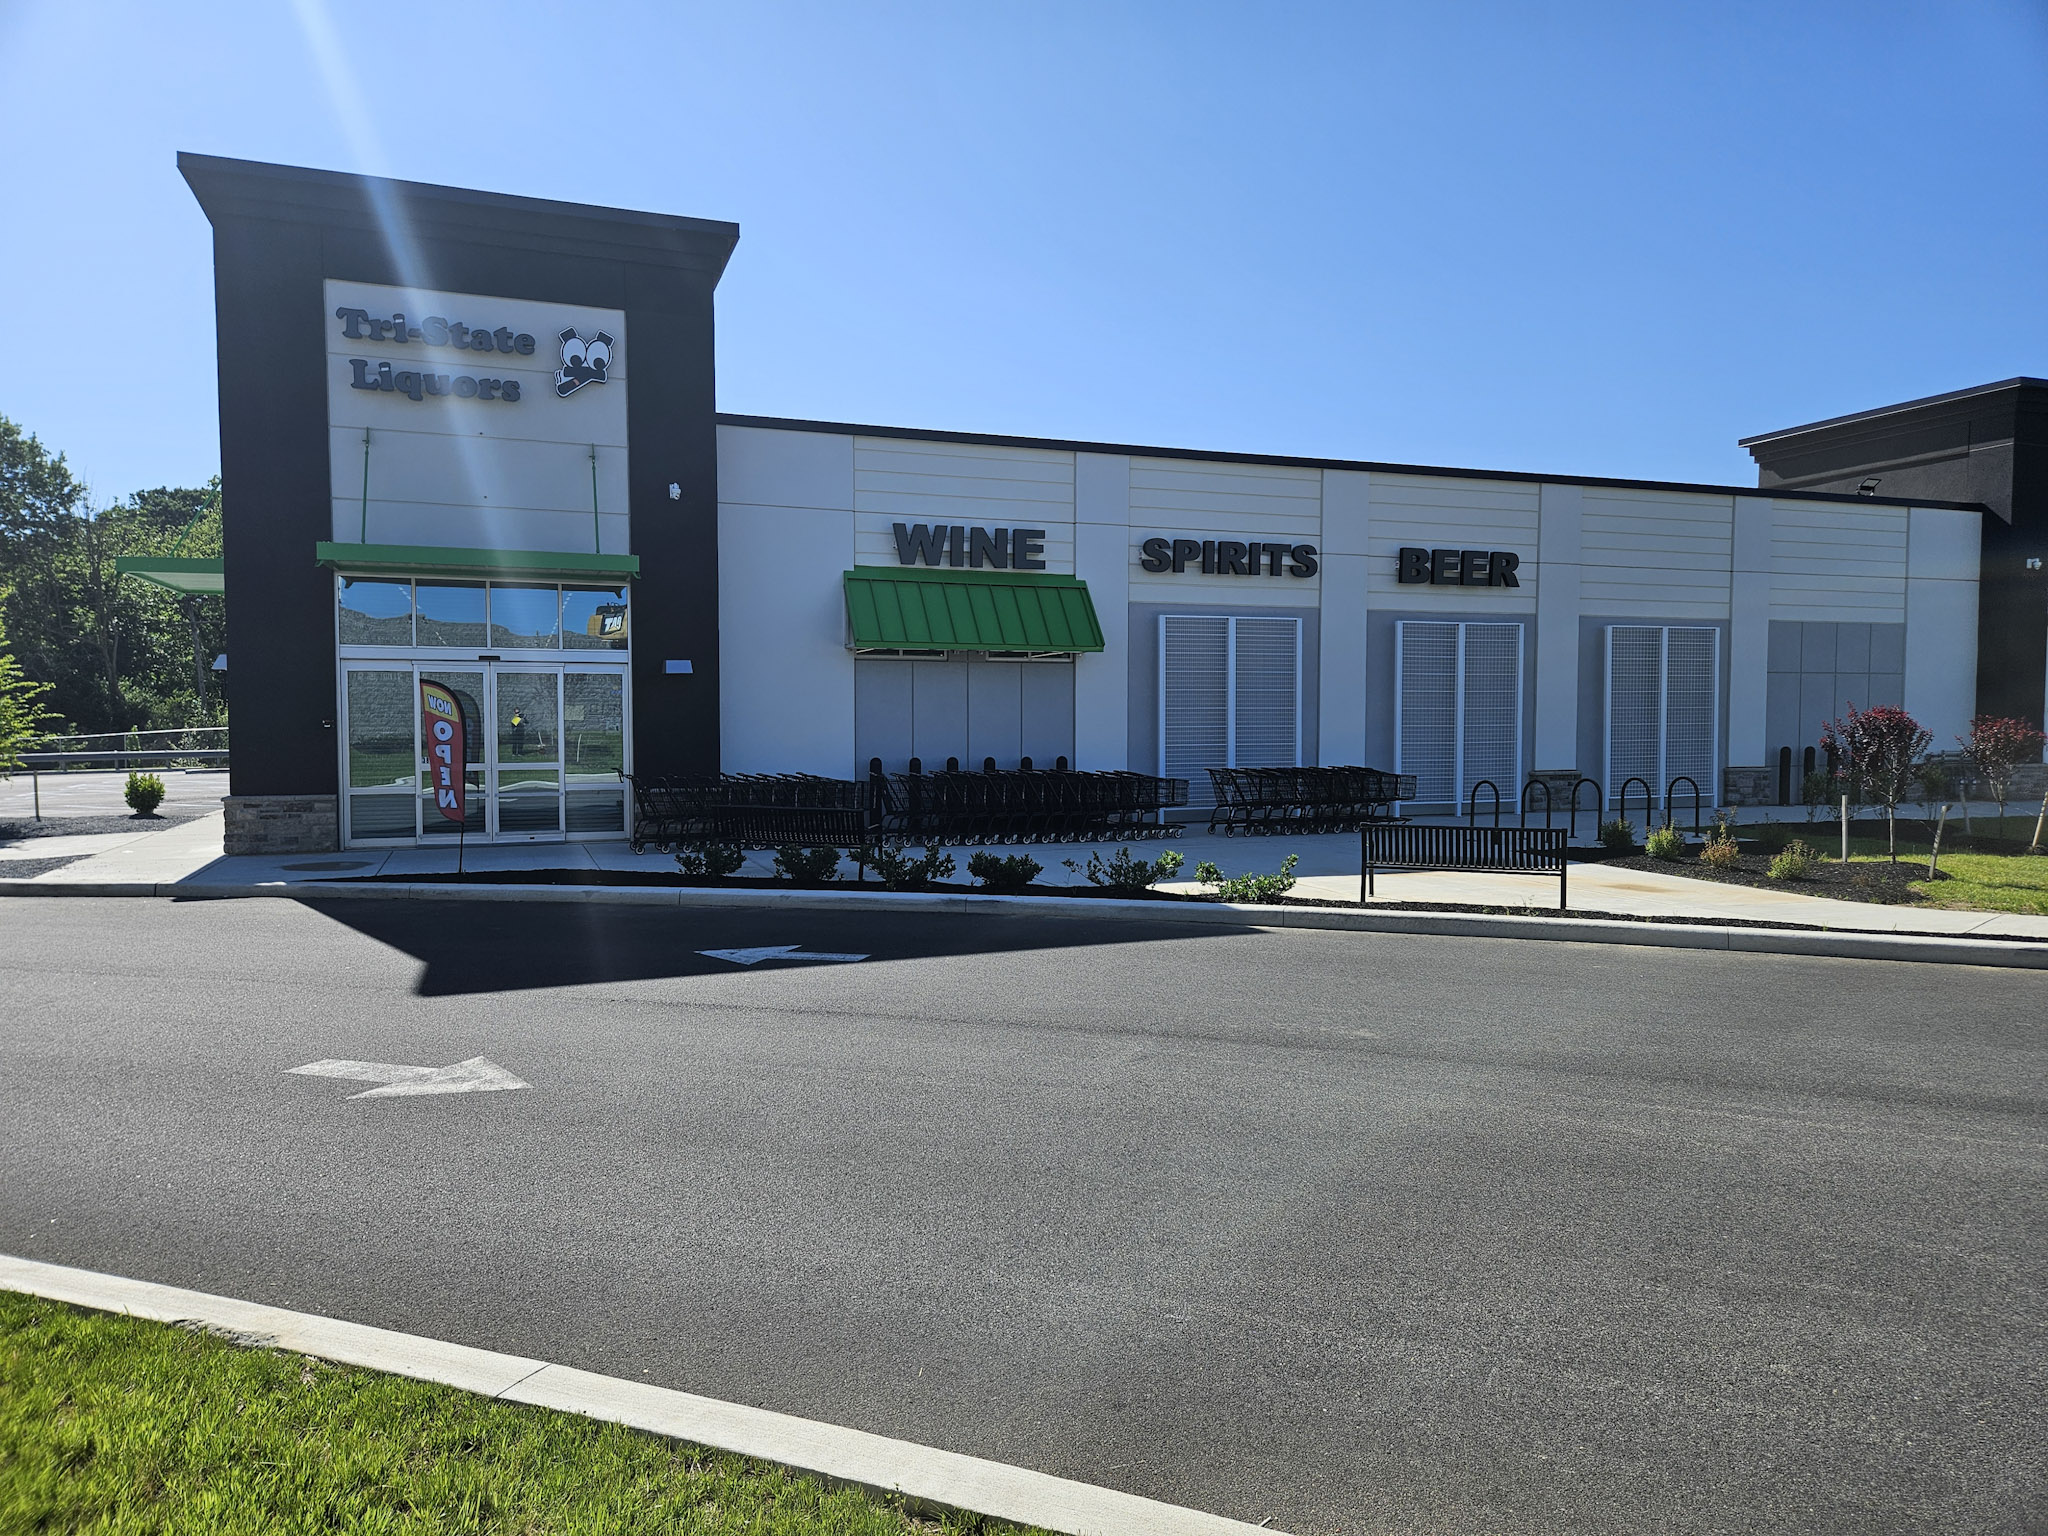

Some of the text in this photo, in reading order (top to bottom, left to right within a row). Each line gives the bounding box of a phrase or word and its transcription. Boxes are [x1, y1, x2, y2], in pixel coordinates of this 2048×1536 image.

[336, 307, 535, 355] Tri-State
[349, 359, 521, 402] Liquors
[893, 523, 1046, 569] WINE
[1142, 537, 1318, 578] SPIRITS
[1398, 547, 1520, 587] BEER
